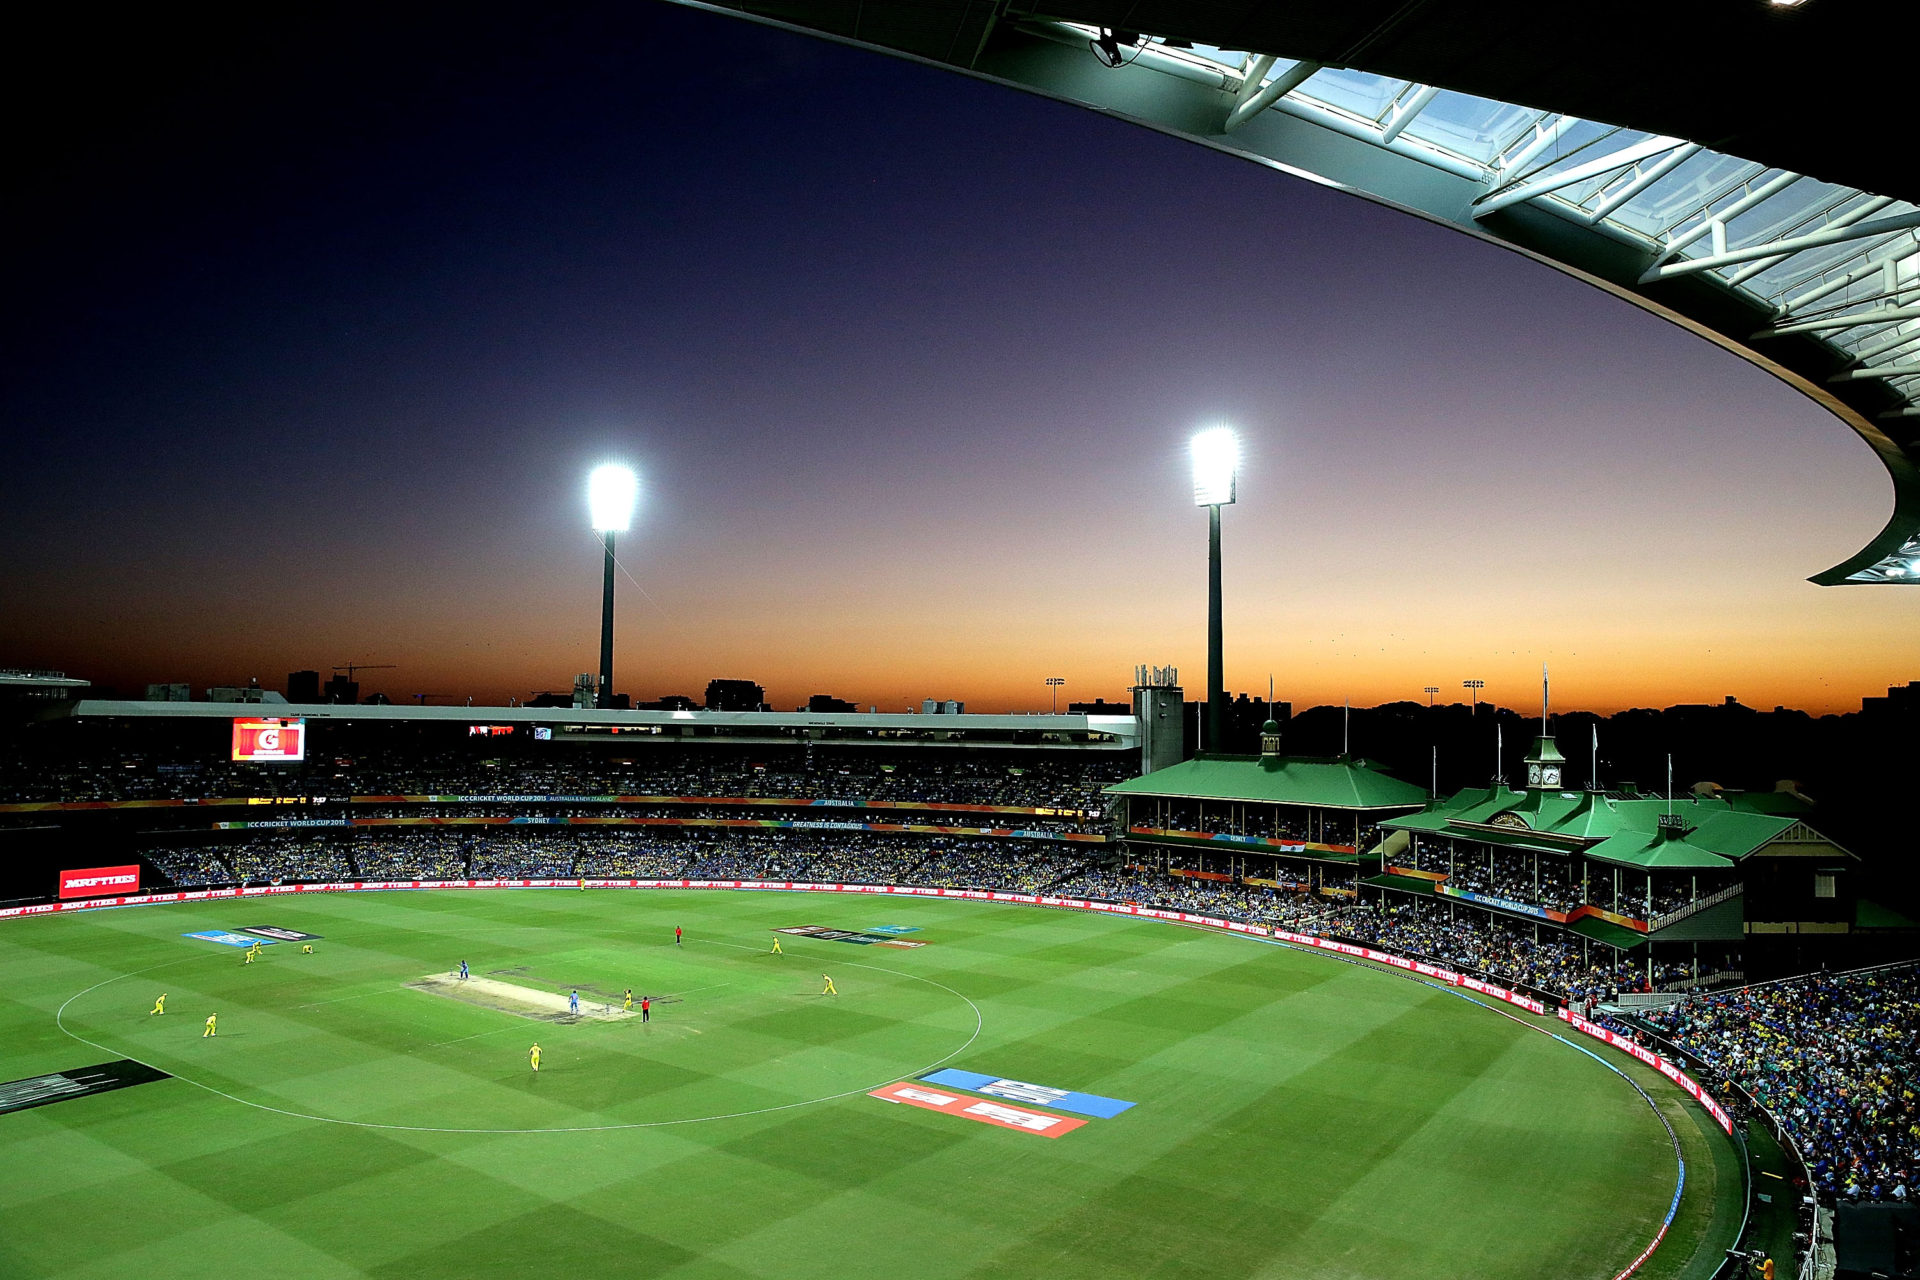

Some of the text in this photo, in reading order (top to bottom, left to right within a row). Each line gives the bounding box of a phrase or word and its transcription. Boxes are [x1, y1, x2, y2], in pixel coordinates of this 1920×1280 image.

[259, 729, 280, 750] G
[1022, 830, 1053, 839] AUSTRALIA
[64, 875, 136, 888] MRF TYRES
[61, 899, 117, 909] MRF TYRES
[124, 893, 178, 903] MRF TYRES
[1482, 896, 1500, 905] CRICKET
[1501, 901, 1518, 910] WORLD
[1518, 903, 1528, 912] CUP
[1527, 906, 1539, 915] 2015
[1511, 994, 1530, 1009] MRF
[1583, 1020, 1606, 1040] TYRES
[1611, 1033, 1656, 1066] MRF TYRES
[1660, 1059, 1697, 1097] MRF TYRES
